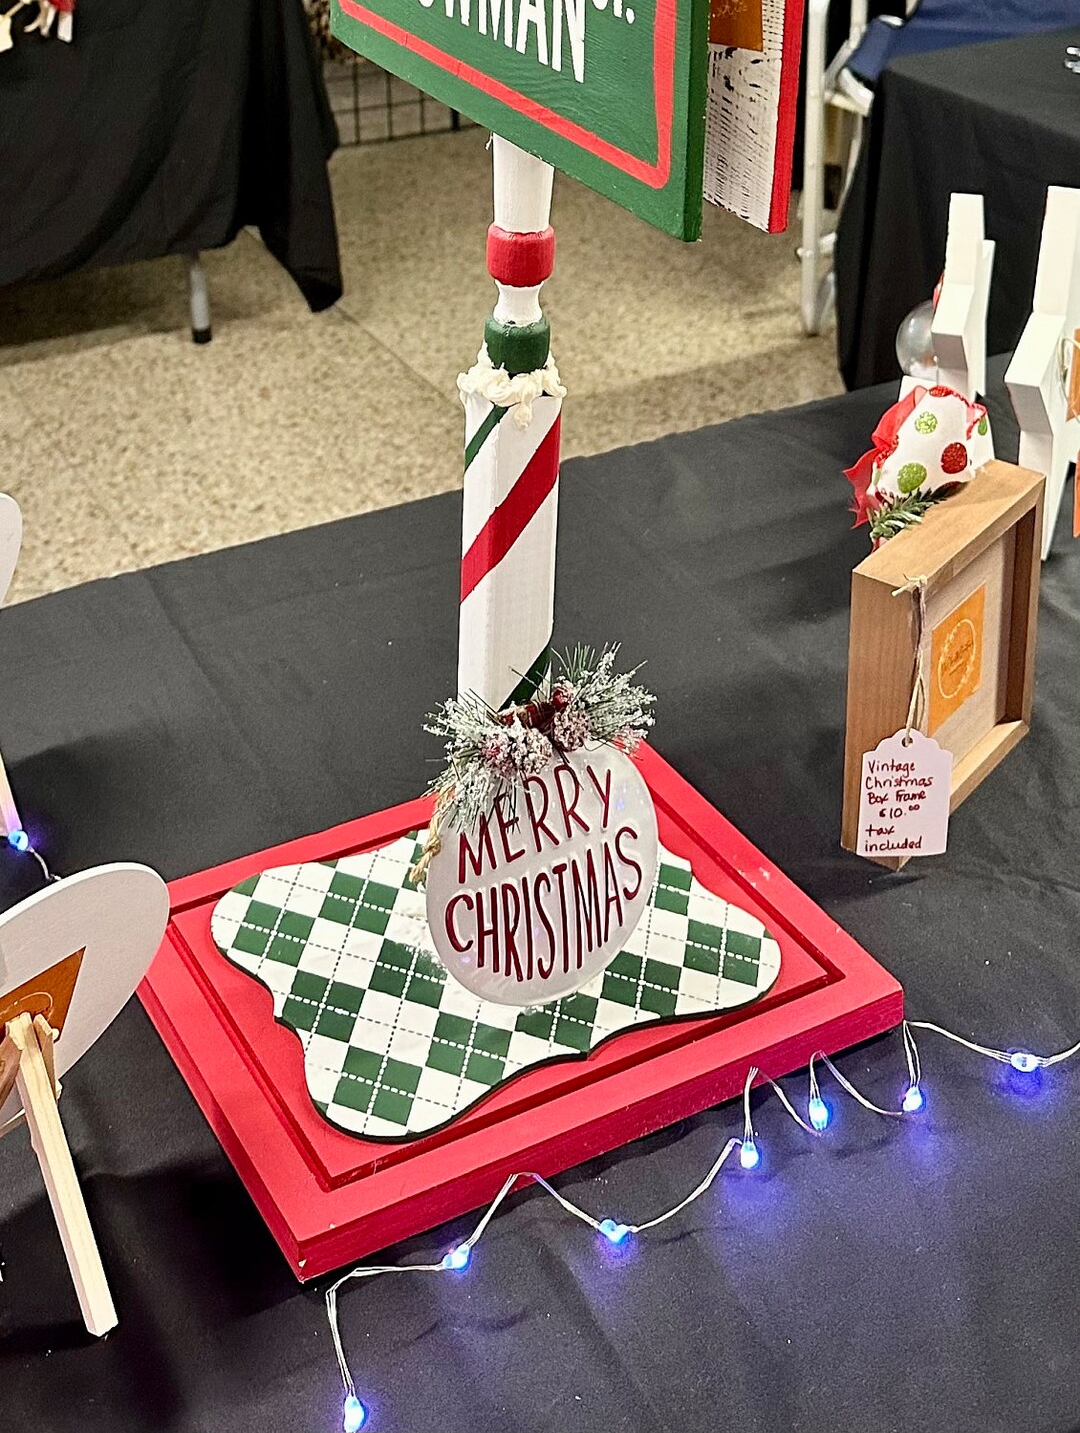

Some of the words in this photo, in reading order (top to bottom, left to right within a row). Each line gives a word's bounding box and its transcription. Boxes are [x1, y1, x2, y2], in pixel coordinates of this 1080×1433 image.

[868, 758, 916, 778] Vintage
[865, 775, 934, 789] Christmas
[867, 792, 889, 805] Box
[895, 790, 926, 802] Frame
[458, 765, 611, 883] MERRY
[865, 824, 895, 837] tax
[865, 835, 922, 852] included
[445, 826, 642, 982] CHRISTMAS
